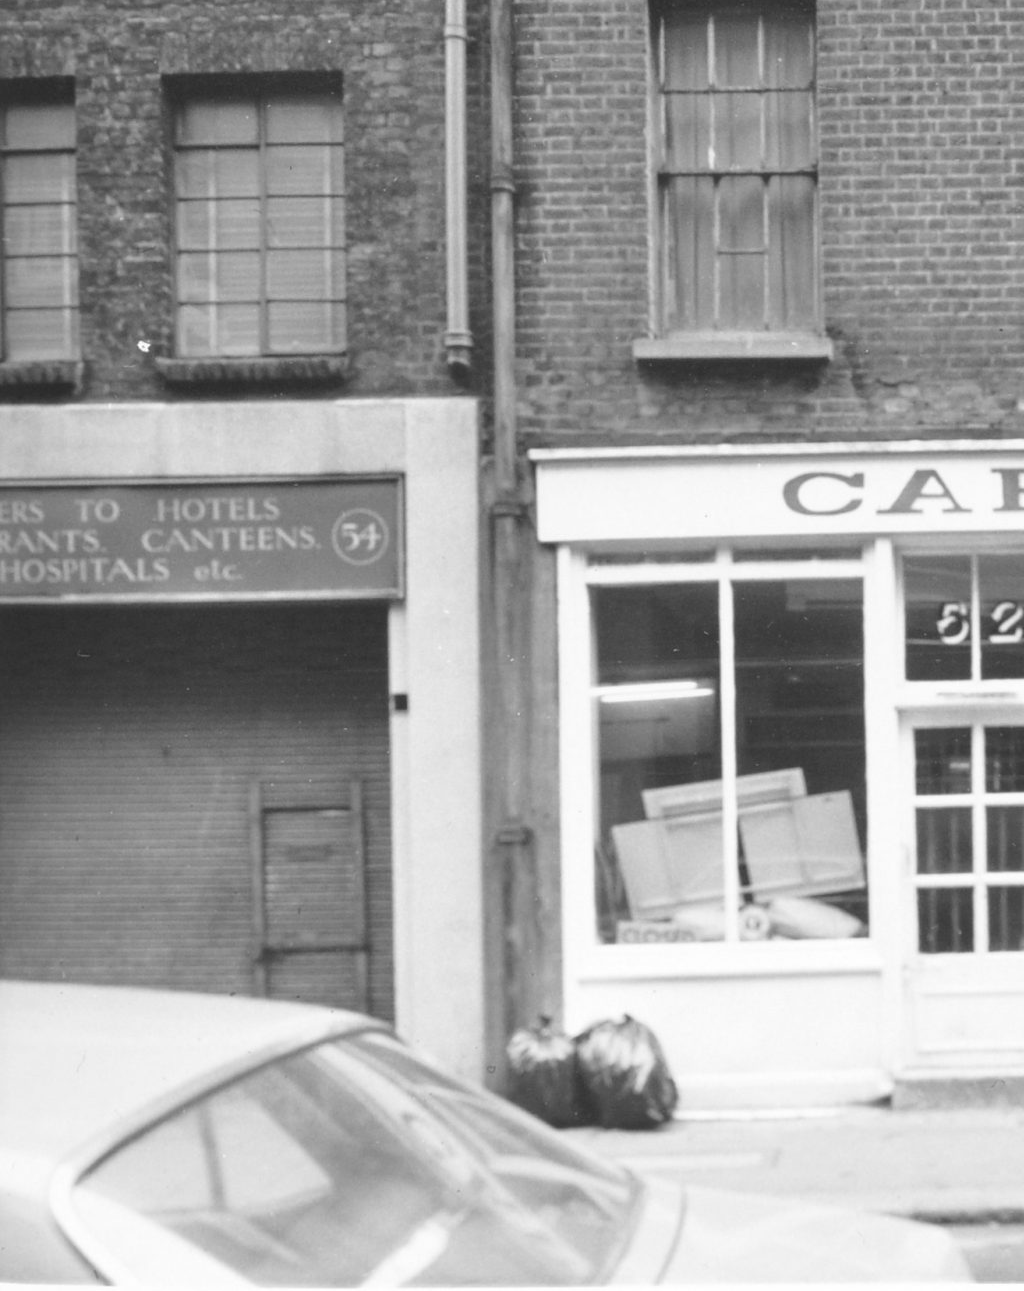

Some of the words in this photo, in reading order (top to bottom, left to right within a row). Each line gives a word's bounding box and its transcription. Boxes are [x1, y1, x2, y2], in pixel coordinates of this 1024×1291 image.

[74, 498, 120, 523] TO
[157, 497, 281, 522] HOTELS
[341, 522, 381, 551] 54
[0, 558, 170, 583] HOSPITALS
[936, 601, 1024, 645] 52
